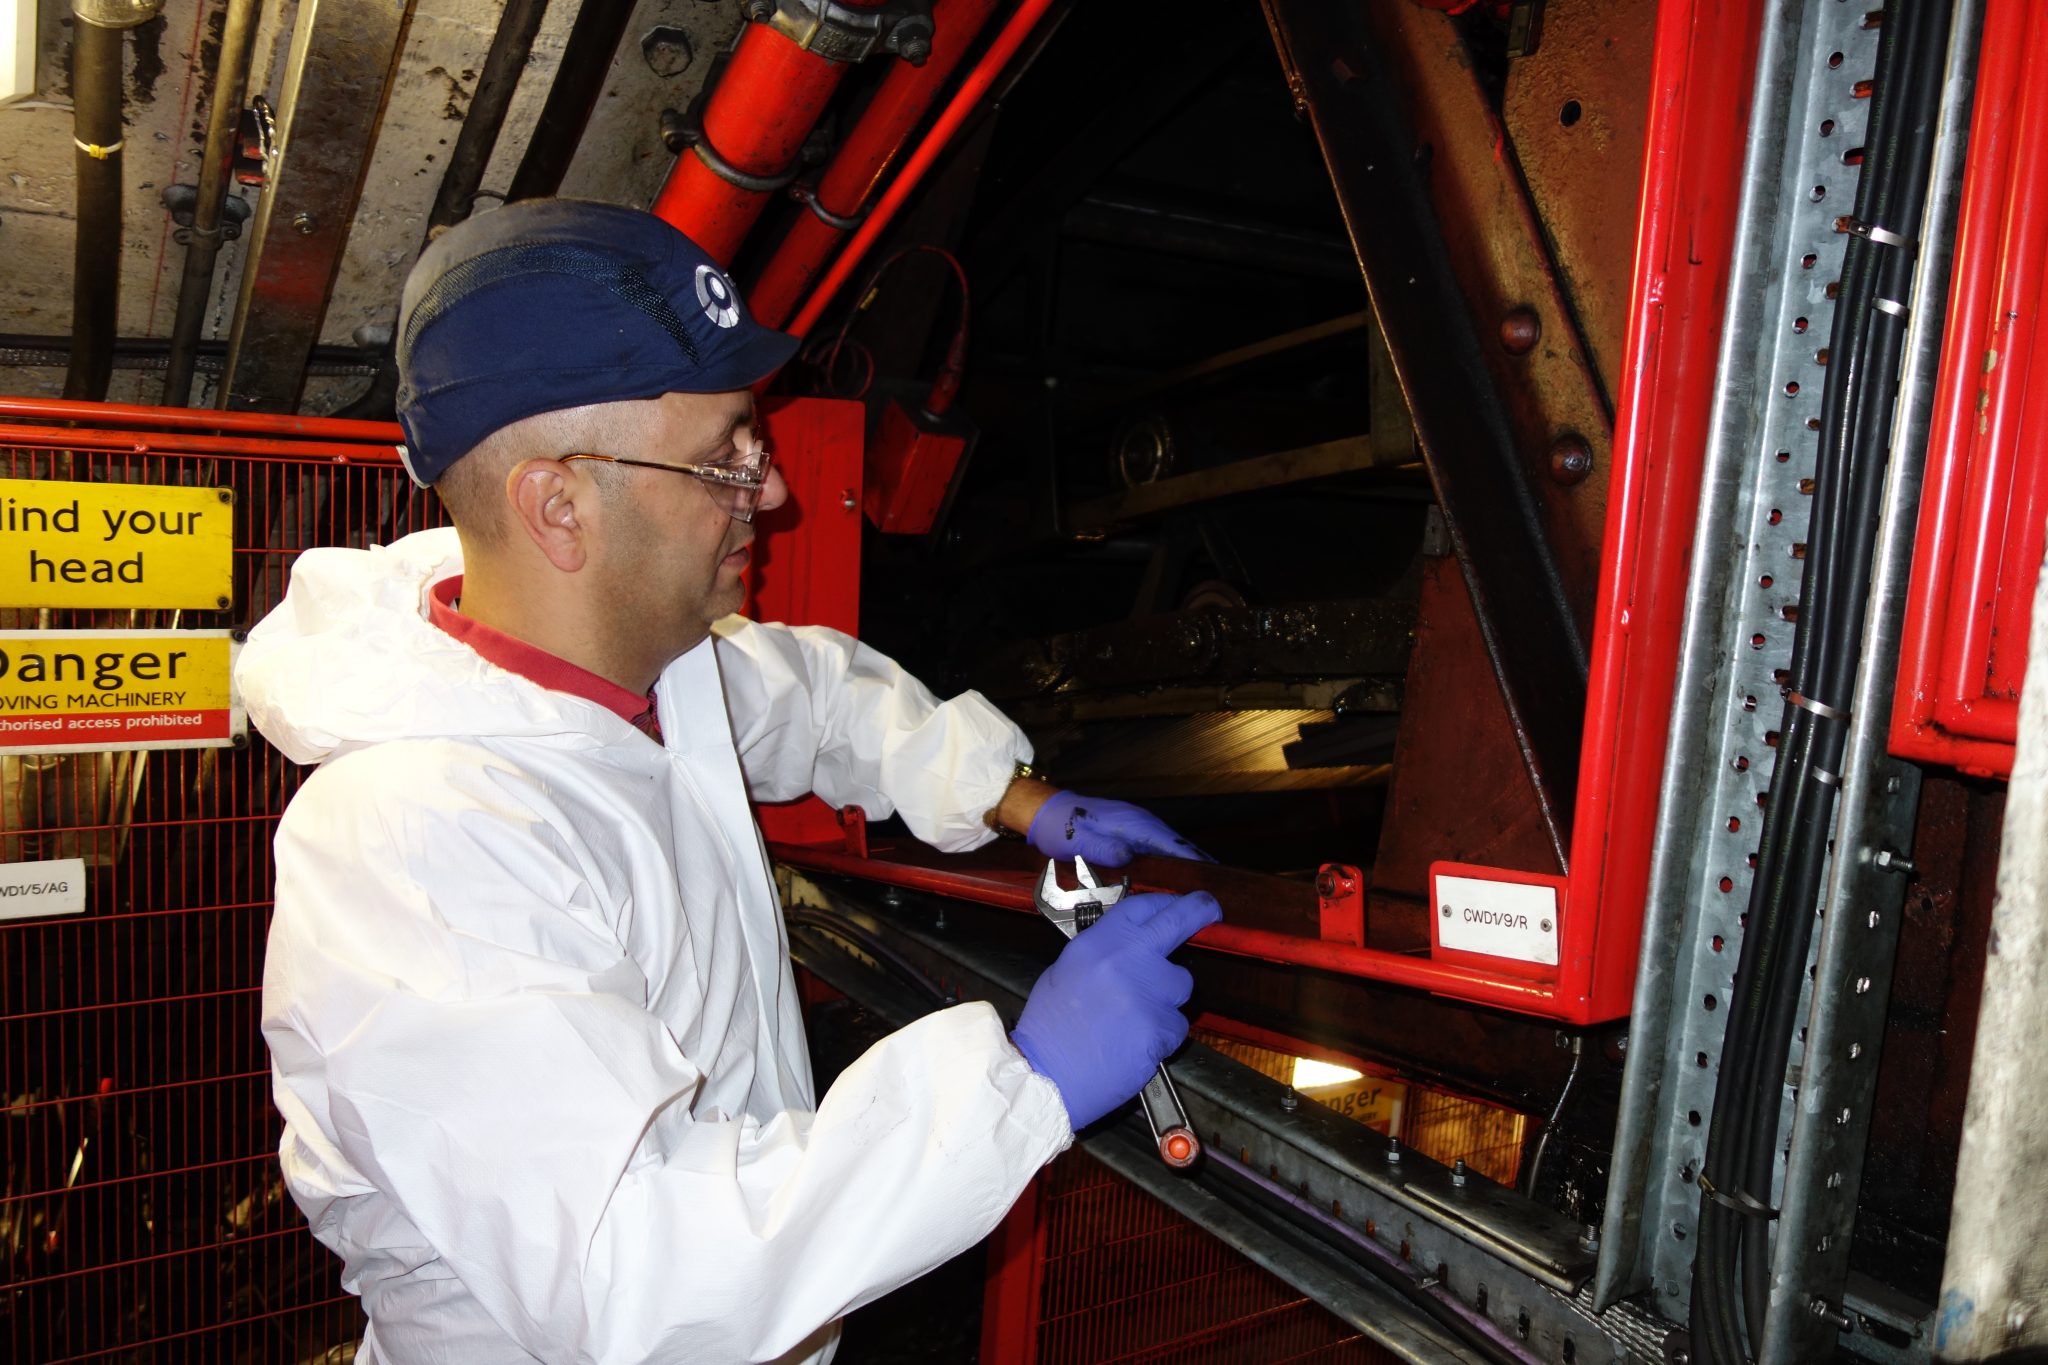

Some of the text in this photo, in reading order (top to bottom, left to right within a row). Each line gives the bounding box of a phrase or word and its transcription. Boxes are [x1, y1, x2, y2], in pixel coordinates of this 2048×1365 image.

[0, 497, 203, 542] ind your
[30, 549, 144, 583] head
[67, 691, 187, 709] MACHINERY
[68, 718, 121, 730] access
[126, 713, 203, 730] prohibited
[1463, 908, 1529, 930] CWD1/9/R
[1320, 1087, 1382, 1117] nger
